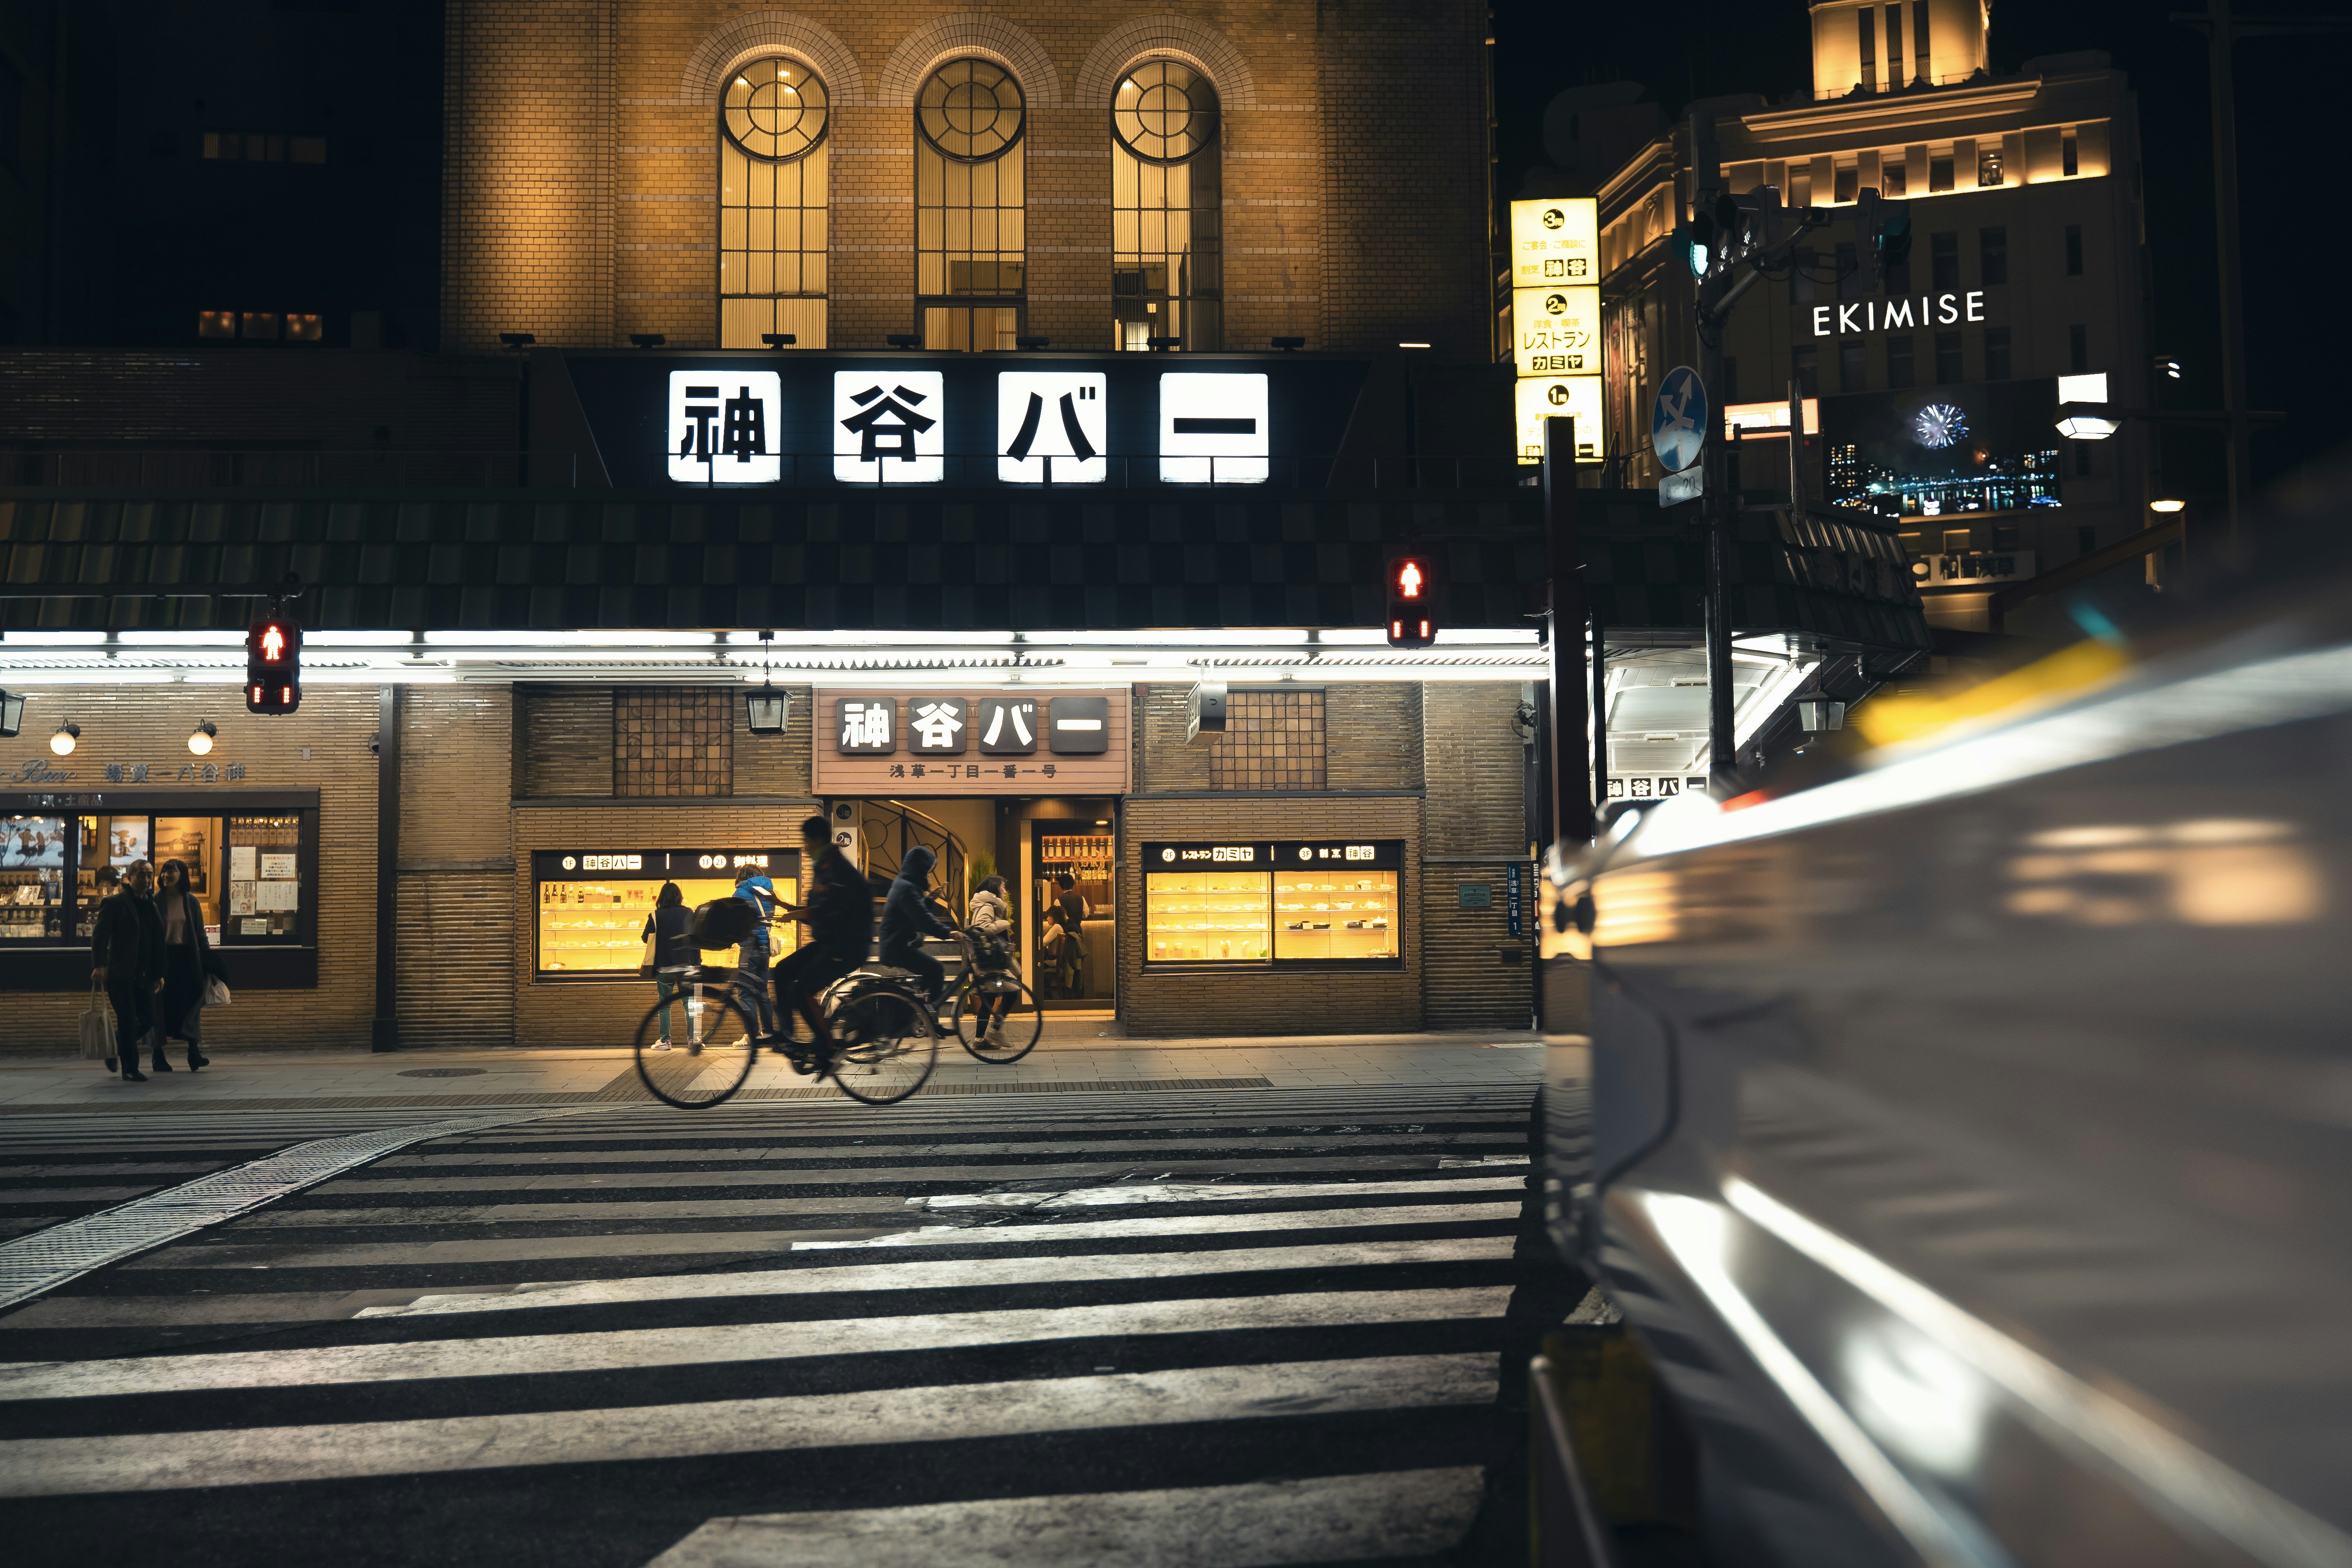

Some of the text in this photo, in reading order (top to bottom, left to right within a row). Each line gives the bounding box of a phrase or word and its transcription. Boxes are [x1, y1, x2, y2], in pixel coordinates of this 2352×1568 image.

[1545, 259, 1586, 277] 神谷
[1813, 291, 1984, 336] EKIMISE
[1524, 331, 1590, 350] レストラン
[1533, 356, 1582, 370] カミヤ
[680, 385, 1256, 463] 神谷バー
[842, 702, 1101, 748] 神谷バー
[12, 759, 77, 783] Bar
[890, 764, 1057, 779] 浅草一丁目一番一号
[838, 835, 851, 845] 2階
[1182, 850, 1212, 860] レストラン
[1214, 848, 1253, 860] カミヤ
[1347, 847, 1373, 859] 神谷
[1513, 922, 1517, 930] 1
